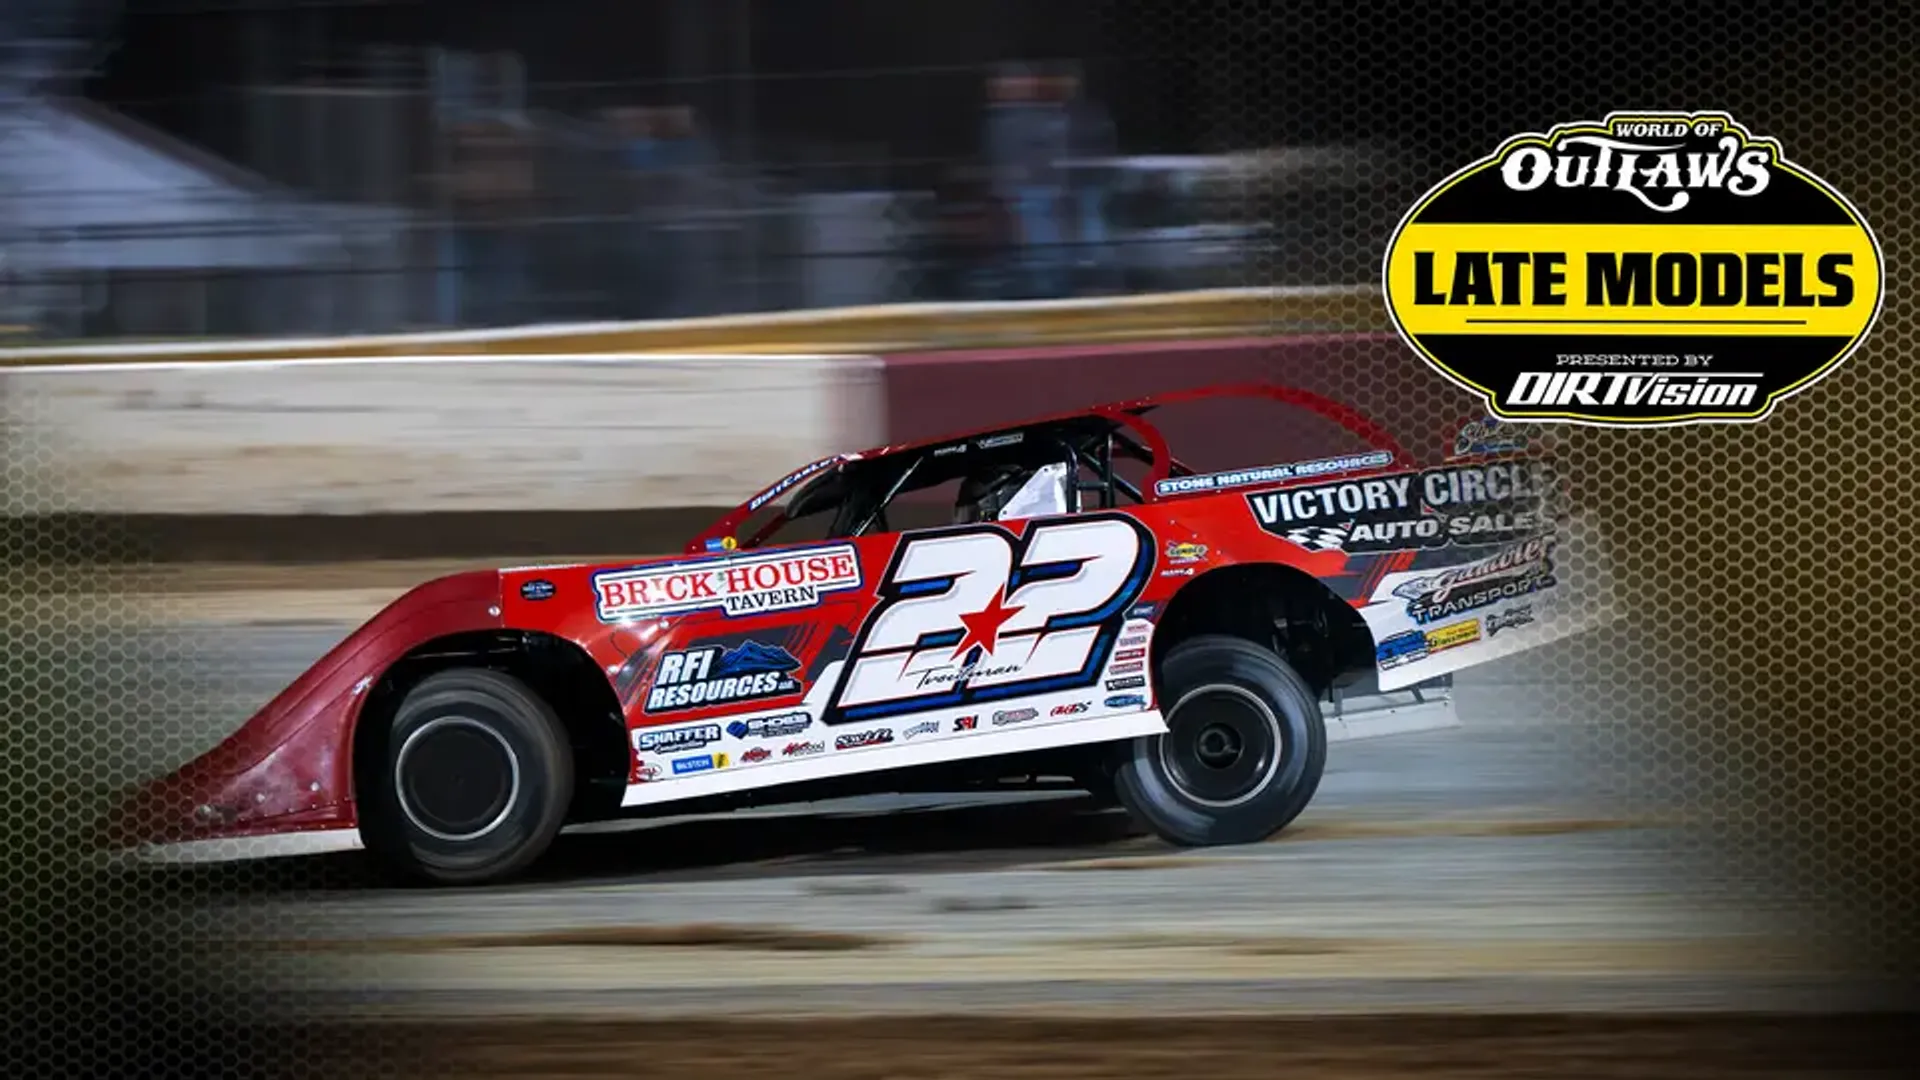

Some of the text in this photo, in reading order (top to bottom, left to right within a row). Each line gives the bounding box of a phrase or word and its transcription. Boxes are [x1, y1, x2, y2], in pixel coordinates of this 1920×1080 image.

[1160, 453, 1390, 494] STONE NATURAL RESOURCES
[1252, 477, 1411, 524] VICTORY
[1350, 519, 1439, 542] AUTO
[724, 554, 855, 594] HOUSE
[726, 585, 816, 611] TAVERN
[830, 516, 1150, 715] 22
[656, 649, 715, 685] RFI
[648, 671, 781, 710] RESOURCES
[641, 726, 719, 749] SHAFFER
